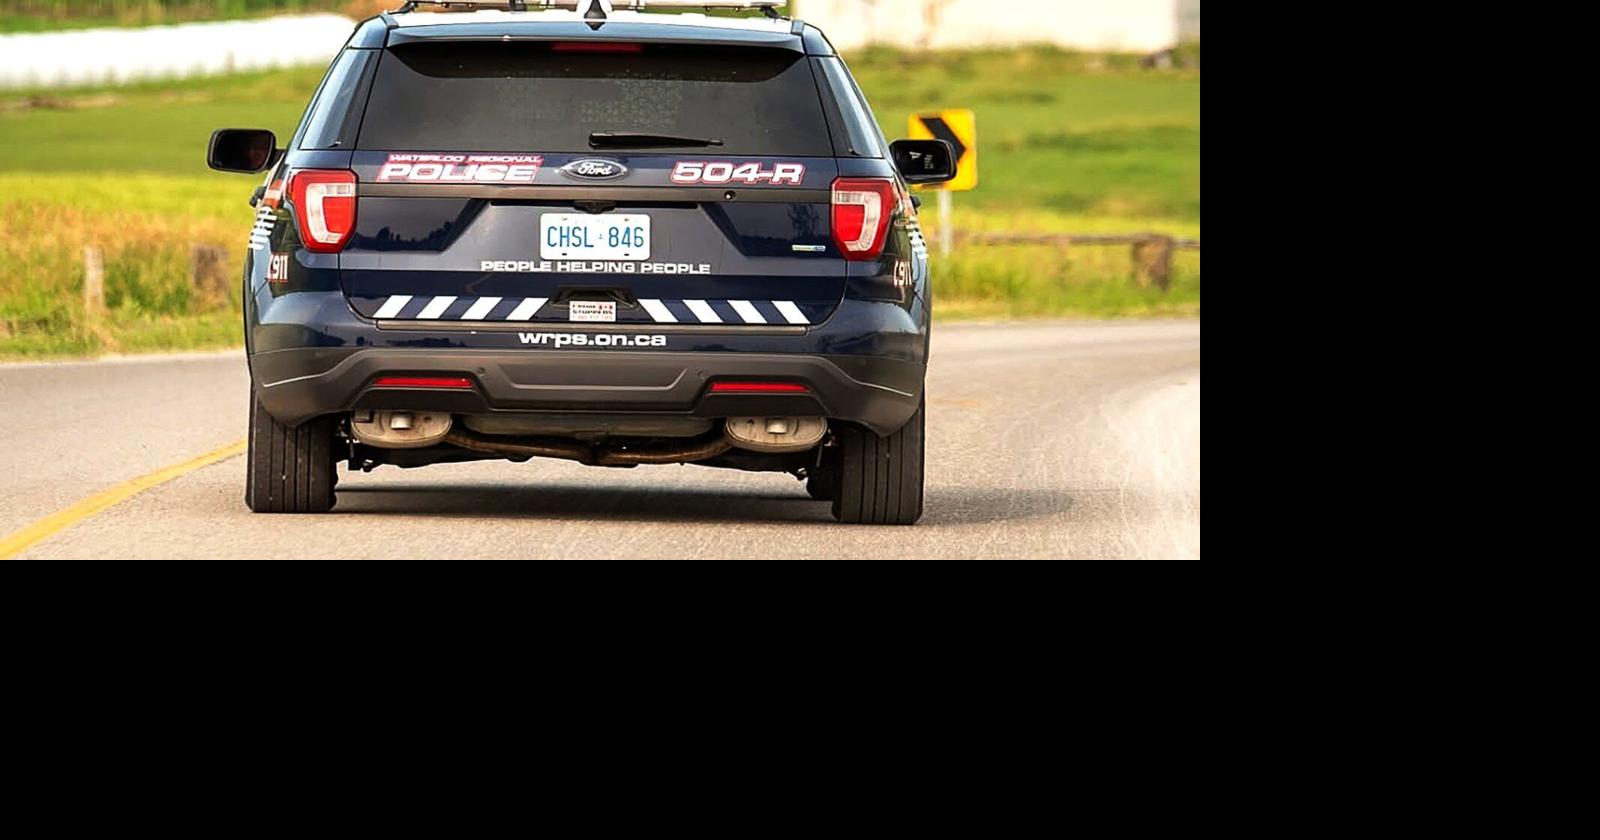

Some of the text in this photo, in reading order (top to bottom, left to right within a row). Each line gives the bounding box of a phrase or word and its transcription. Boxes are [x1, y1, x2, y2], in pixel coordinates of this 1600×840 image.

[377, 163, 540, 183] POLICE
[577, 162, 612, 175] Ford
[671, 161, 805, 184] 504-R
[547, 226, 644, 248] CHSL 846
[480, 261, 711, 274] PEOPLE HELPING PEOPLE
[518, 332, 667, 348] wrps.on.ca
